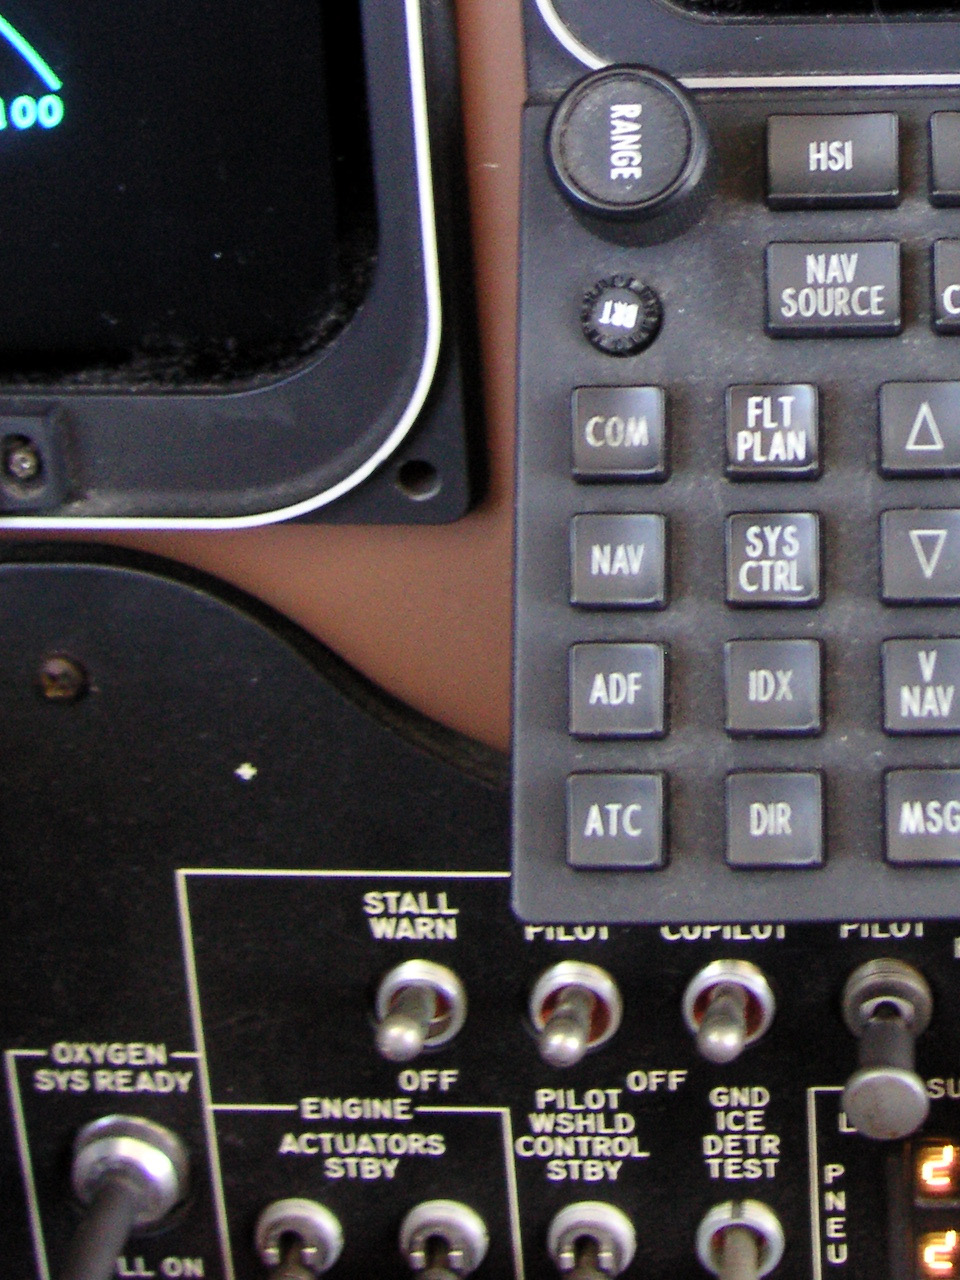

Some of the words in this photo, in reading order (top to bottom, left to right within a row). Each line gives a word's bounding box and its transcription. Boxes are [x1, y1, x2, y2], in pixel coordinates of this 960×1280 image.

[610, 103, 643, 180] RANGE
[809, 141, 854, 172] HSI
[806, 253, 858, 283] NAV
[781, 285, 885, 318] SOURCE
[747, 396, 795, 428] FLT
[585, 416, 649, 448] COM
[737, 429, 807, 463] PLAN
[745, 525, 799, 558] SYS
[590, 543, 645, 577] NAV
[738, 560, 804, 594] CTRL
[917, 649, 938, 683] V
[589, 672, 643, 706] ADF
[748, 670, 795, 703] IDX
[900, 684, 955, 718] NAV
[584, 803, 643, 838] ATC
[749, 803, 792, 836] DIR
[362, 891, 460, 916] STALL
[368, 917, 458, 941] WARN
[52, 1042, 168, 1066] OXYGEN
[33, 1069, 90, 1092] SYS
[96, 1070, 194, 1093] READY
[398, 1069, 459, 1091] OFF
[626, 1070, 688, 1093] OFF
[535, 1089, 623, 1110] PILOT
[709, 1086, 770, 1108] GND
[299, 1098, 414, 1121] ENGINE
[716, 1110, 766, 1132] ICE
[528, 1113, 636, 1134] WSHLD
[278, 1133, 446, 1156] ACTUATORS
[514, 1135, 651, 1158] CONTROL
[702, 1134, 781, 1156] DETR
[323, 1157, 400, 1180] STBY
[546, 1160, 624, 1182] STBY
[704, 1158, 780, 1180] TEST
[161, 1256, 204, 1278] ON
